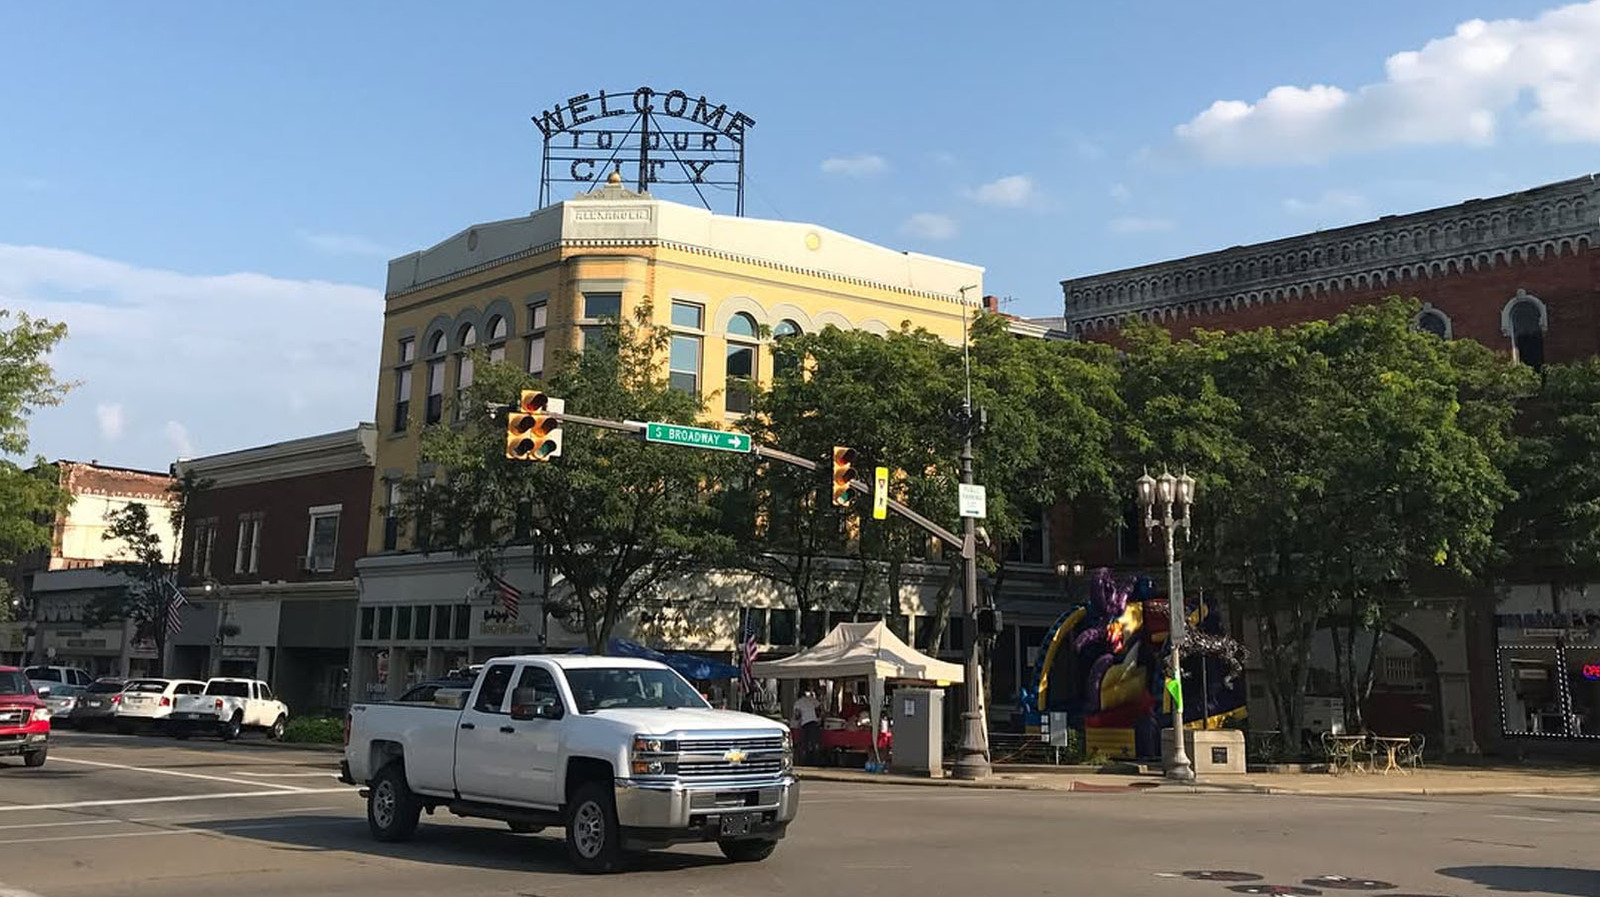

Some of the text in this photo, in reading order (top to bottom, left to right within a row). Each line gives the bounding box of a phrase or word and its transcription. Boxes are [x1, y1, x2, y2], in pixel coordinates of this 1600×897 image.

[531, 87, 756, 144] WELCOME
[570, 131, 718, 151] TO OUR
[570, 158, 714, 183] CITY
[655, 426, 720, 445] S BROADWAY
